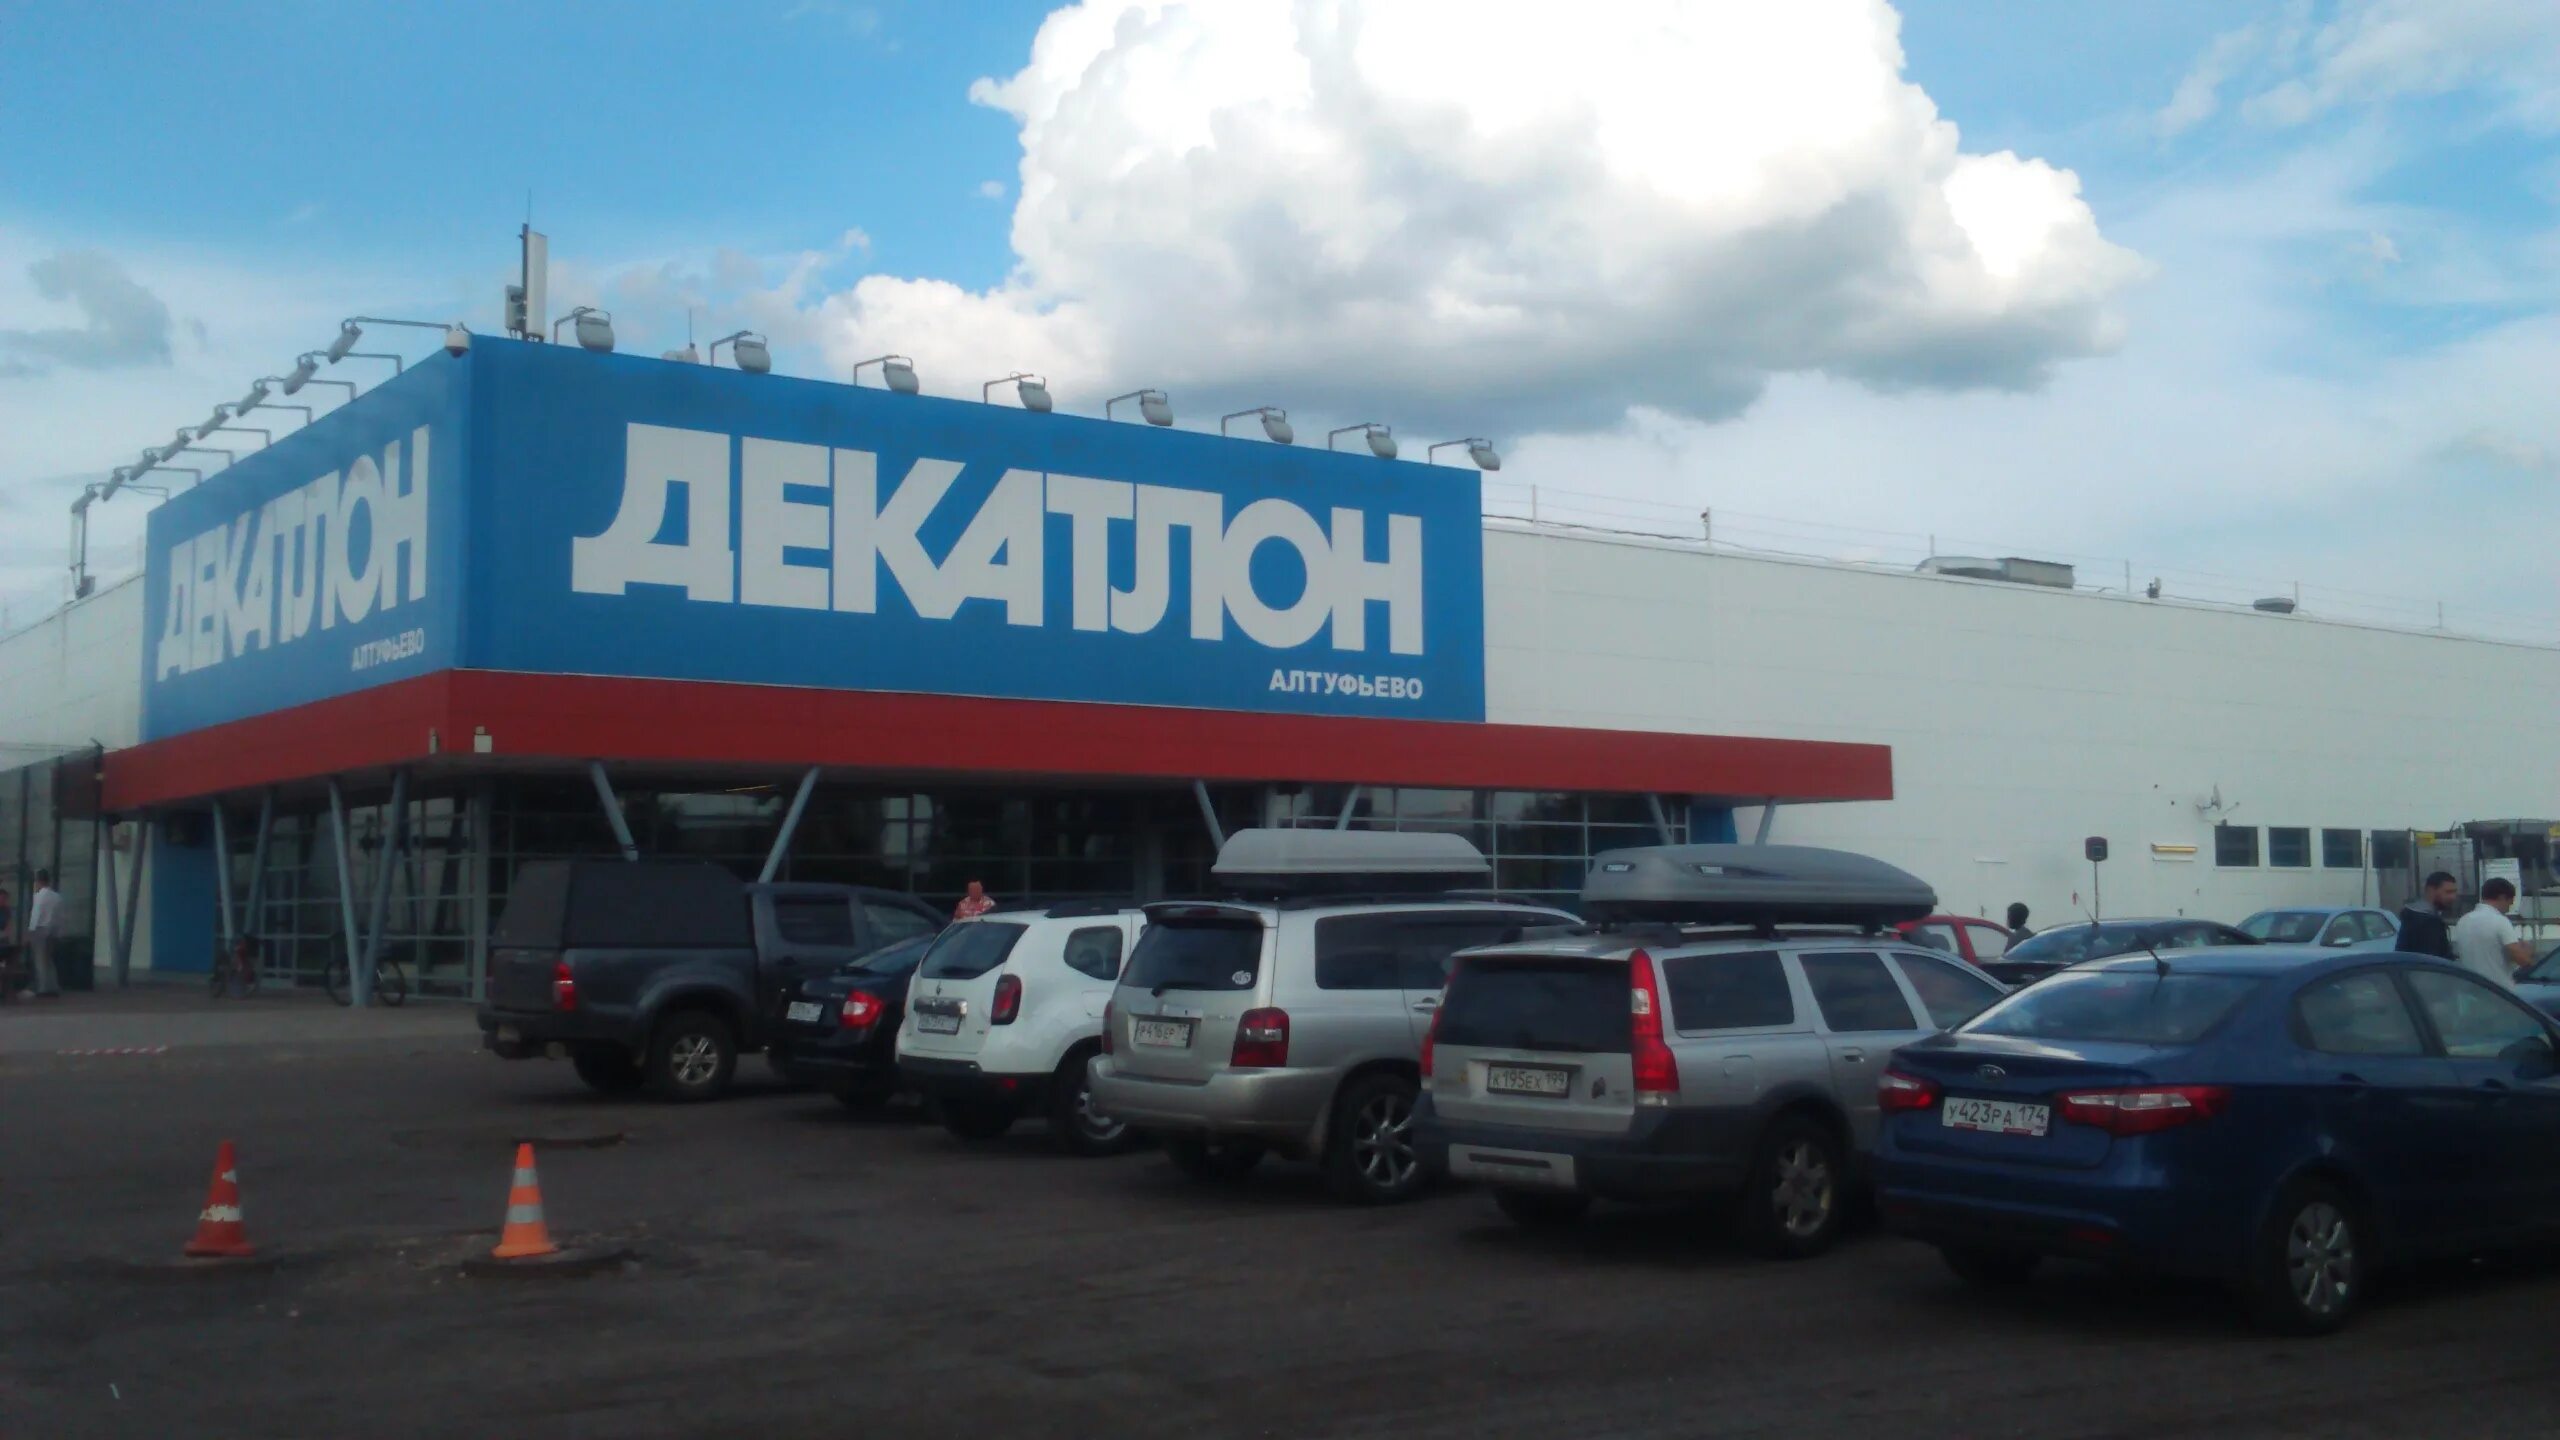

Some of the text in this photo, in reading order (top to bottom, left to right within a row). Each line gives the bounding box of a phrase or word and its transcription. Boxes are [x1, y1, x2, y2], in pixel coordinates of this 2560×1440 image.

[156, 424, 430, 682] ДЕКАТЛОН
[572, 421, 1424, 656] ДЕКАТЛОН
[352, 628, 425, 672] АЛТУФЬЕВО
[1268, 668, 1424, 699] АЛТУФЬЕВО
[1948, 1102, 2046, 1125] У423РА 174
